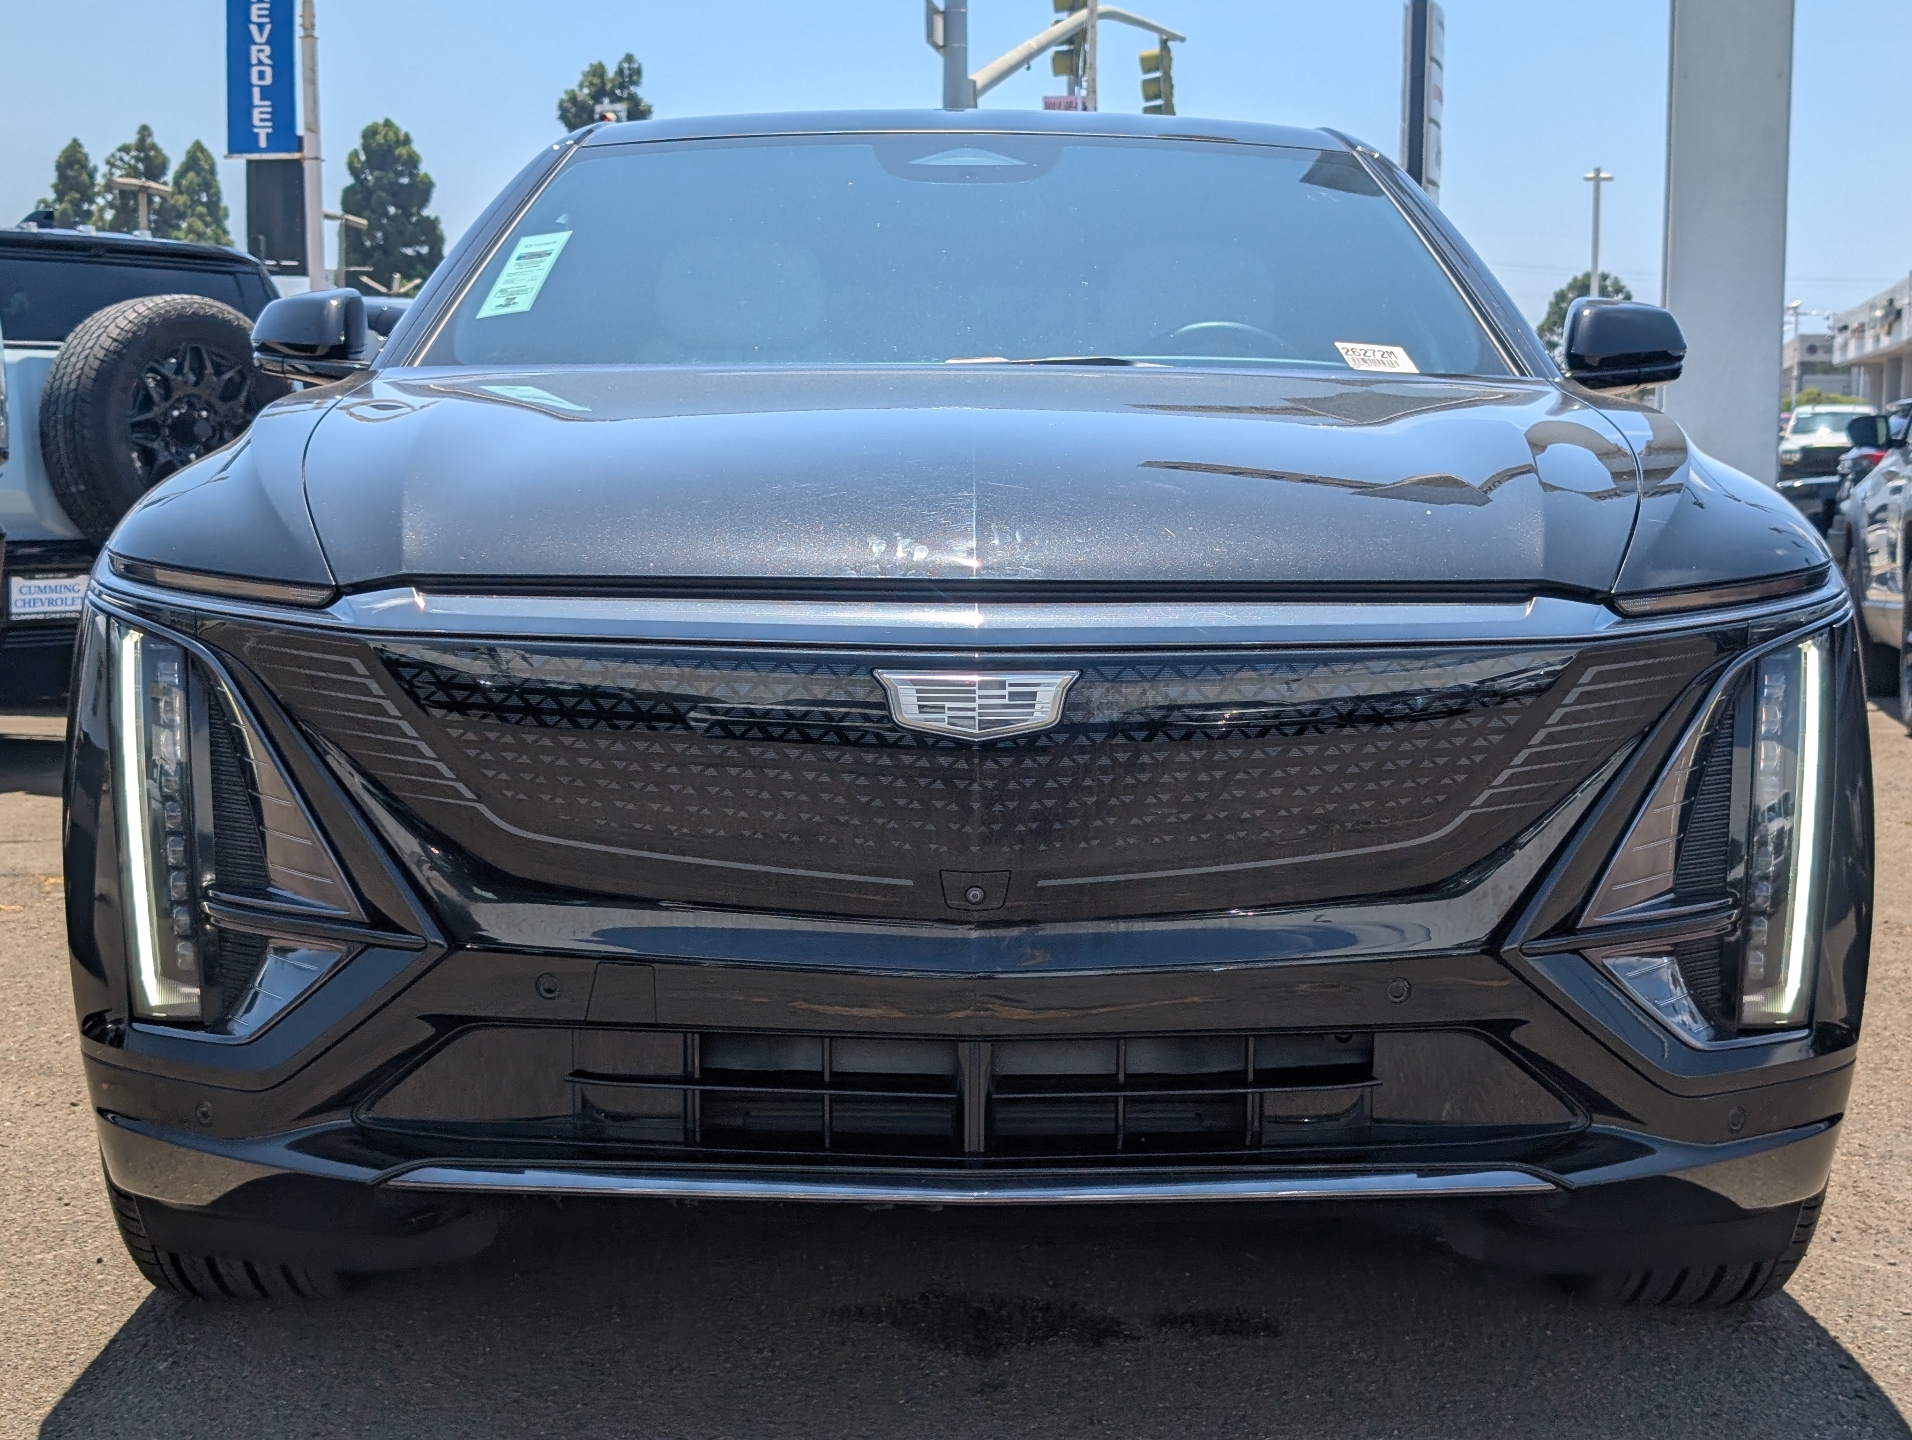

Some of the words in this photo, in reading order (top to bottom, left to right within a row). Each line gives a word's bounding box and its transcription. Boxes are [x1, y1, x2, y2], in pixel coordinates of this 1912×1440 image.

[248, 0, 273, 149] EVROLET
[1341, 347, 1399, 360] 26272M
[19, 582, 81, 596] CUMMING
